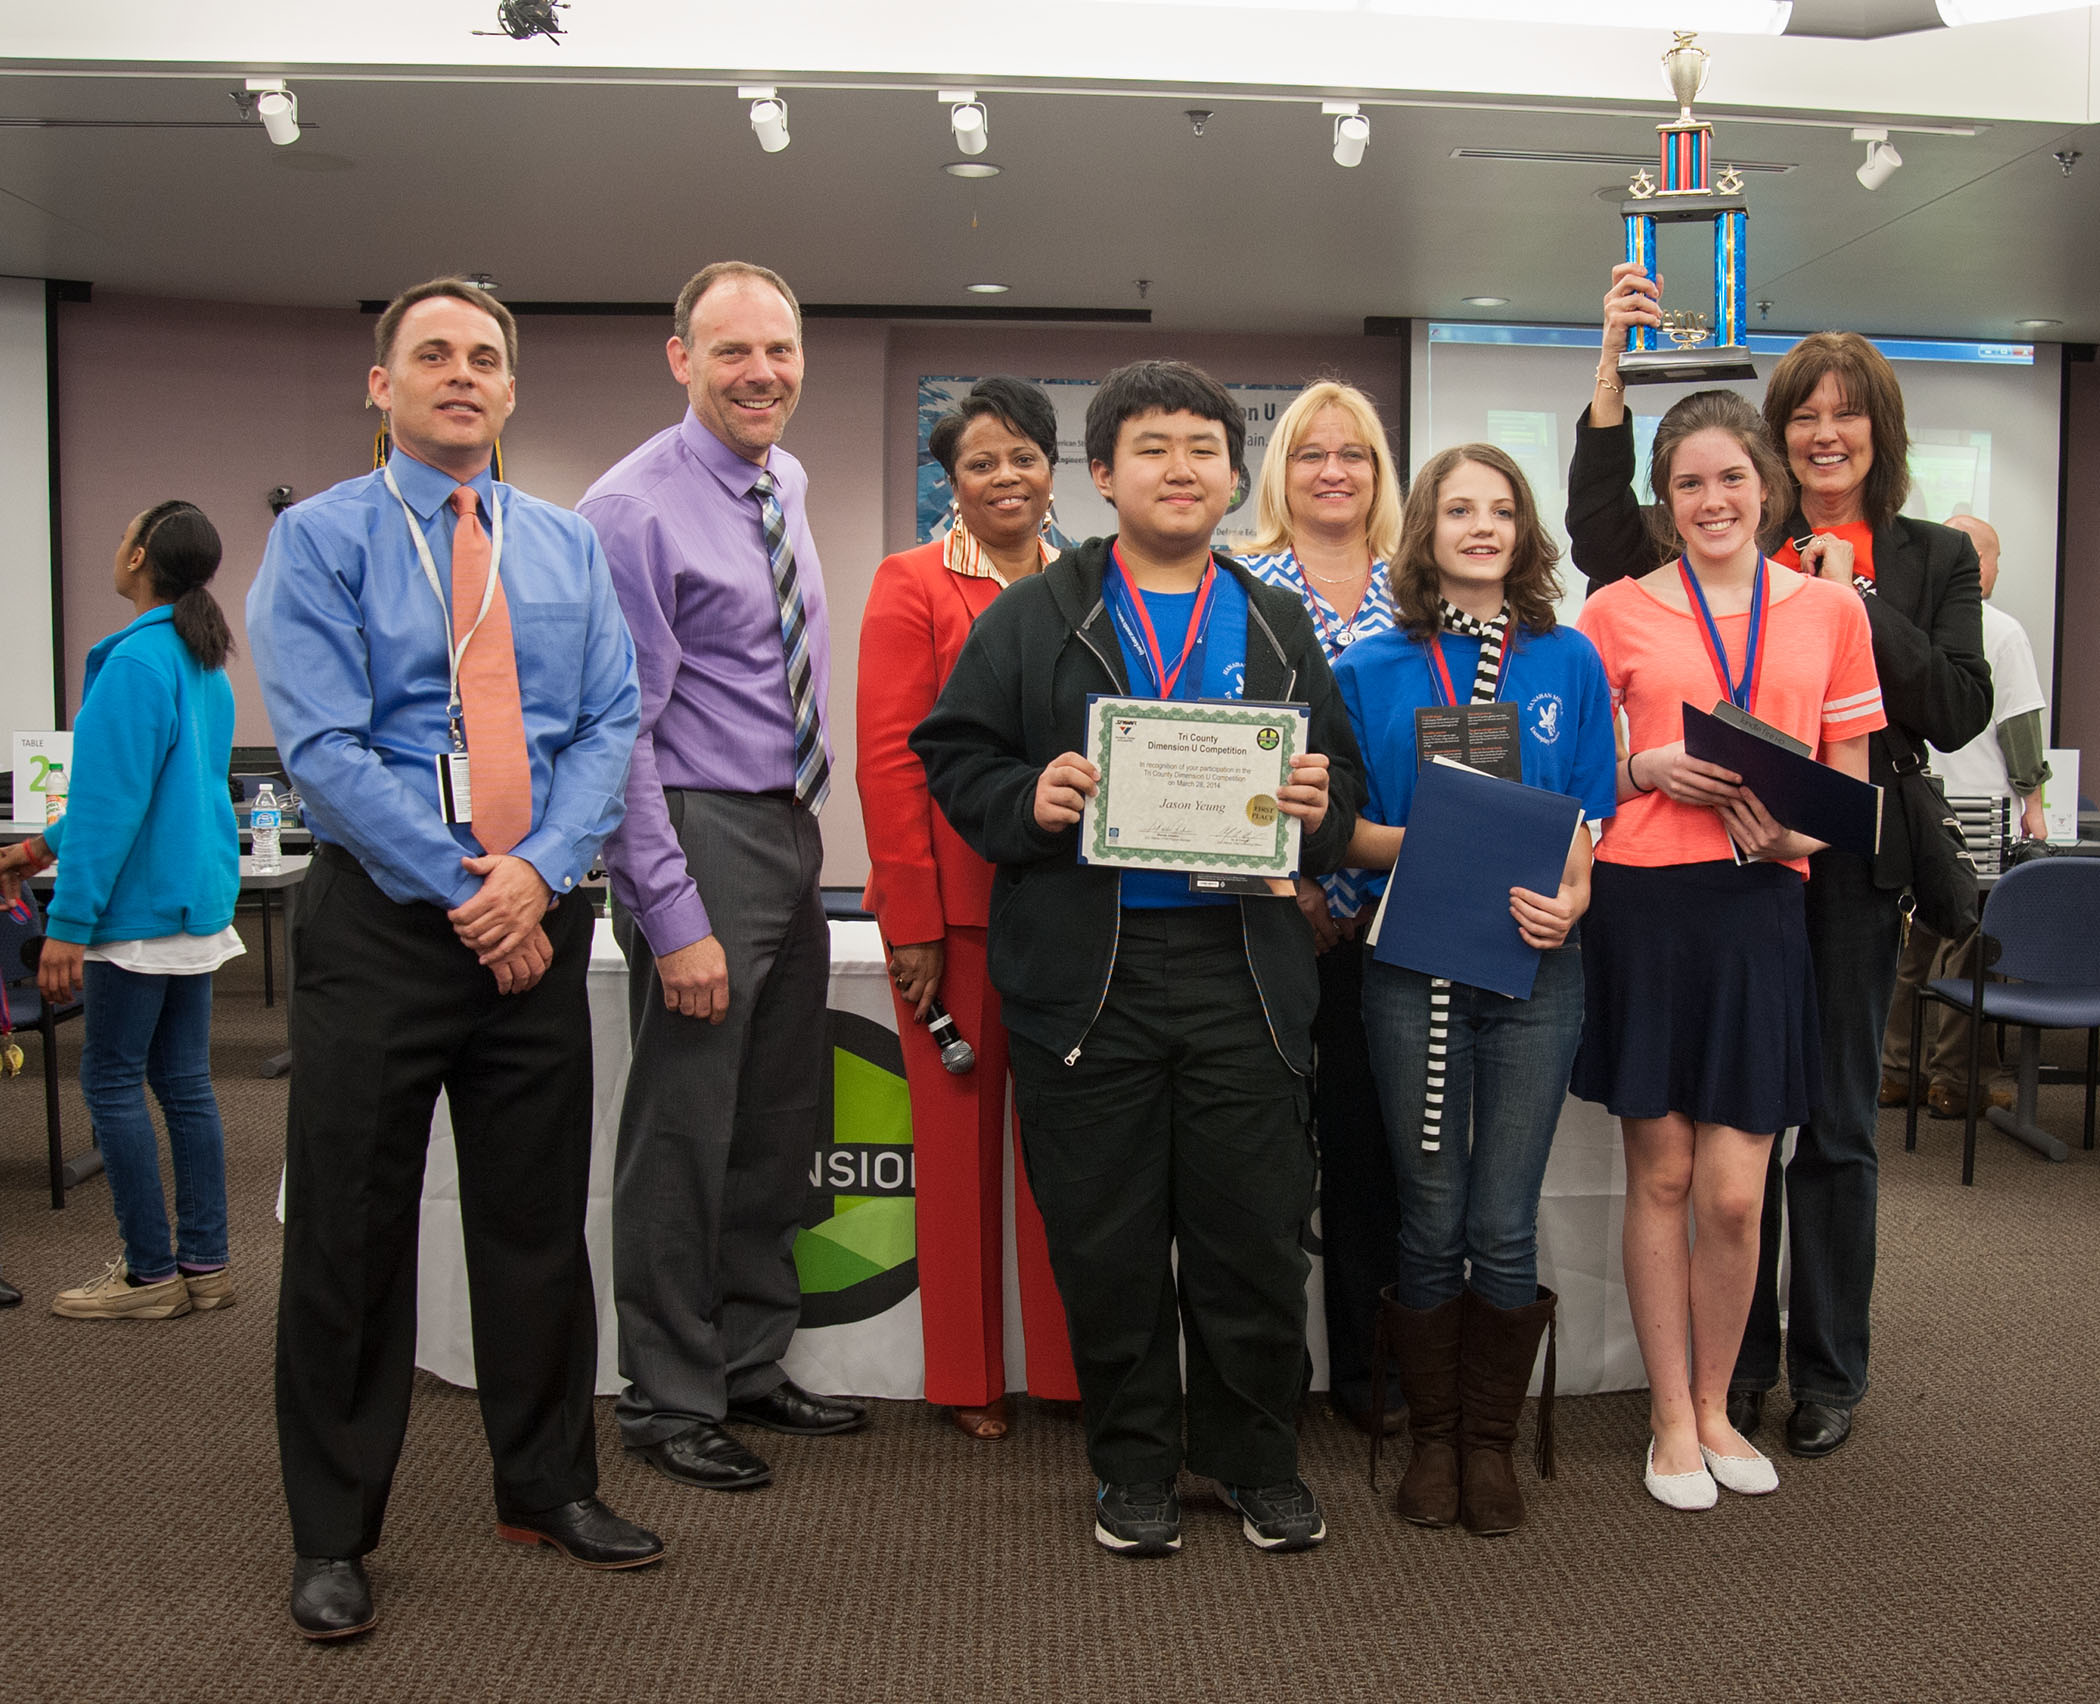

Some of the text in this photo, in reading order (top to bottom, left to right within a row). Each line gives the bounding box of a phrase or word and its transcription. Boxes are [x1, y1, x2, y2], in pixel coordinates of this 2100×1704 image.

[1264, 402, 1276, 421] U
[21, 739, 44, 747] TABLE
[1178, 732, 1218, 745] Tri County
[1148, 741, 1247, 756] Dimension U Competition
[29, 755, 50, 792] 2
[1146, 761, 1178, 770] recognition
[1200, 765, 1234, 774] participation
[1242, 767, 1252, 775] the
[1152, 769, 1173, 779] County
[1174, 771, 1205, 780] Dimension
[1205, 773, 1211, 781] U
[1212, 774, 1247, 783] Competition
[1176, 779, 1195, 787] March
[1158, 798, 1226, 814] Jason Yeung
[1253, 805, 1274, 814] FIRST
[1251, 812, 1273, 821] PLACE
[809, 1151, 916, 1188] NSIO
